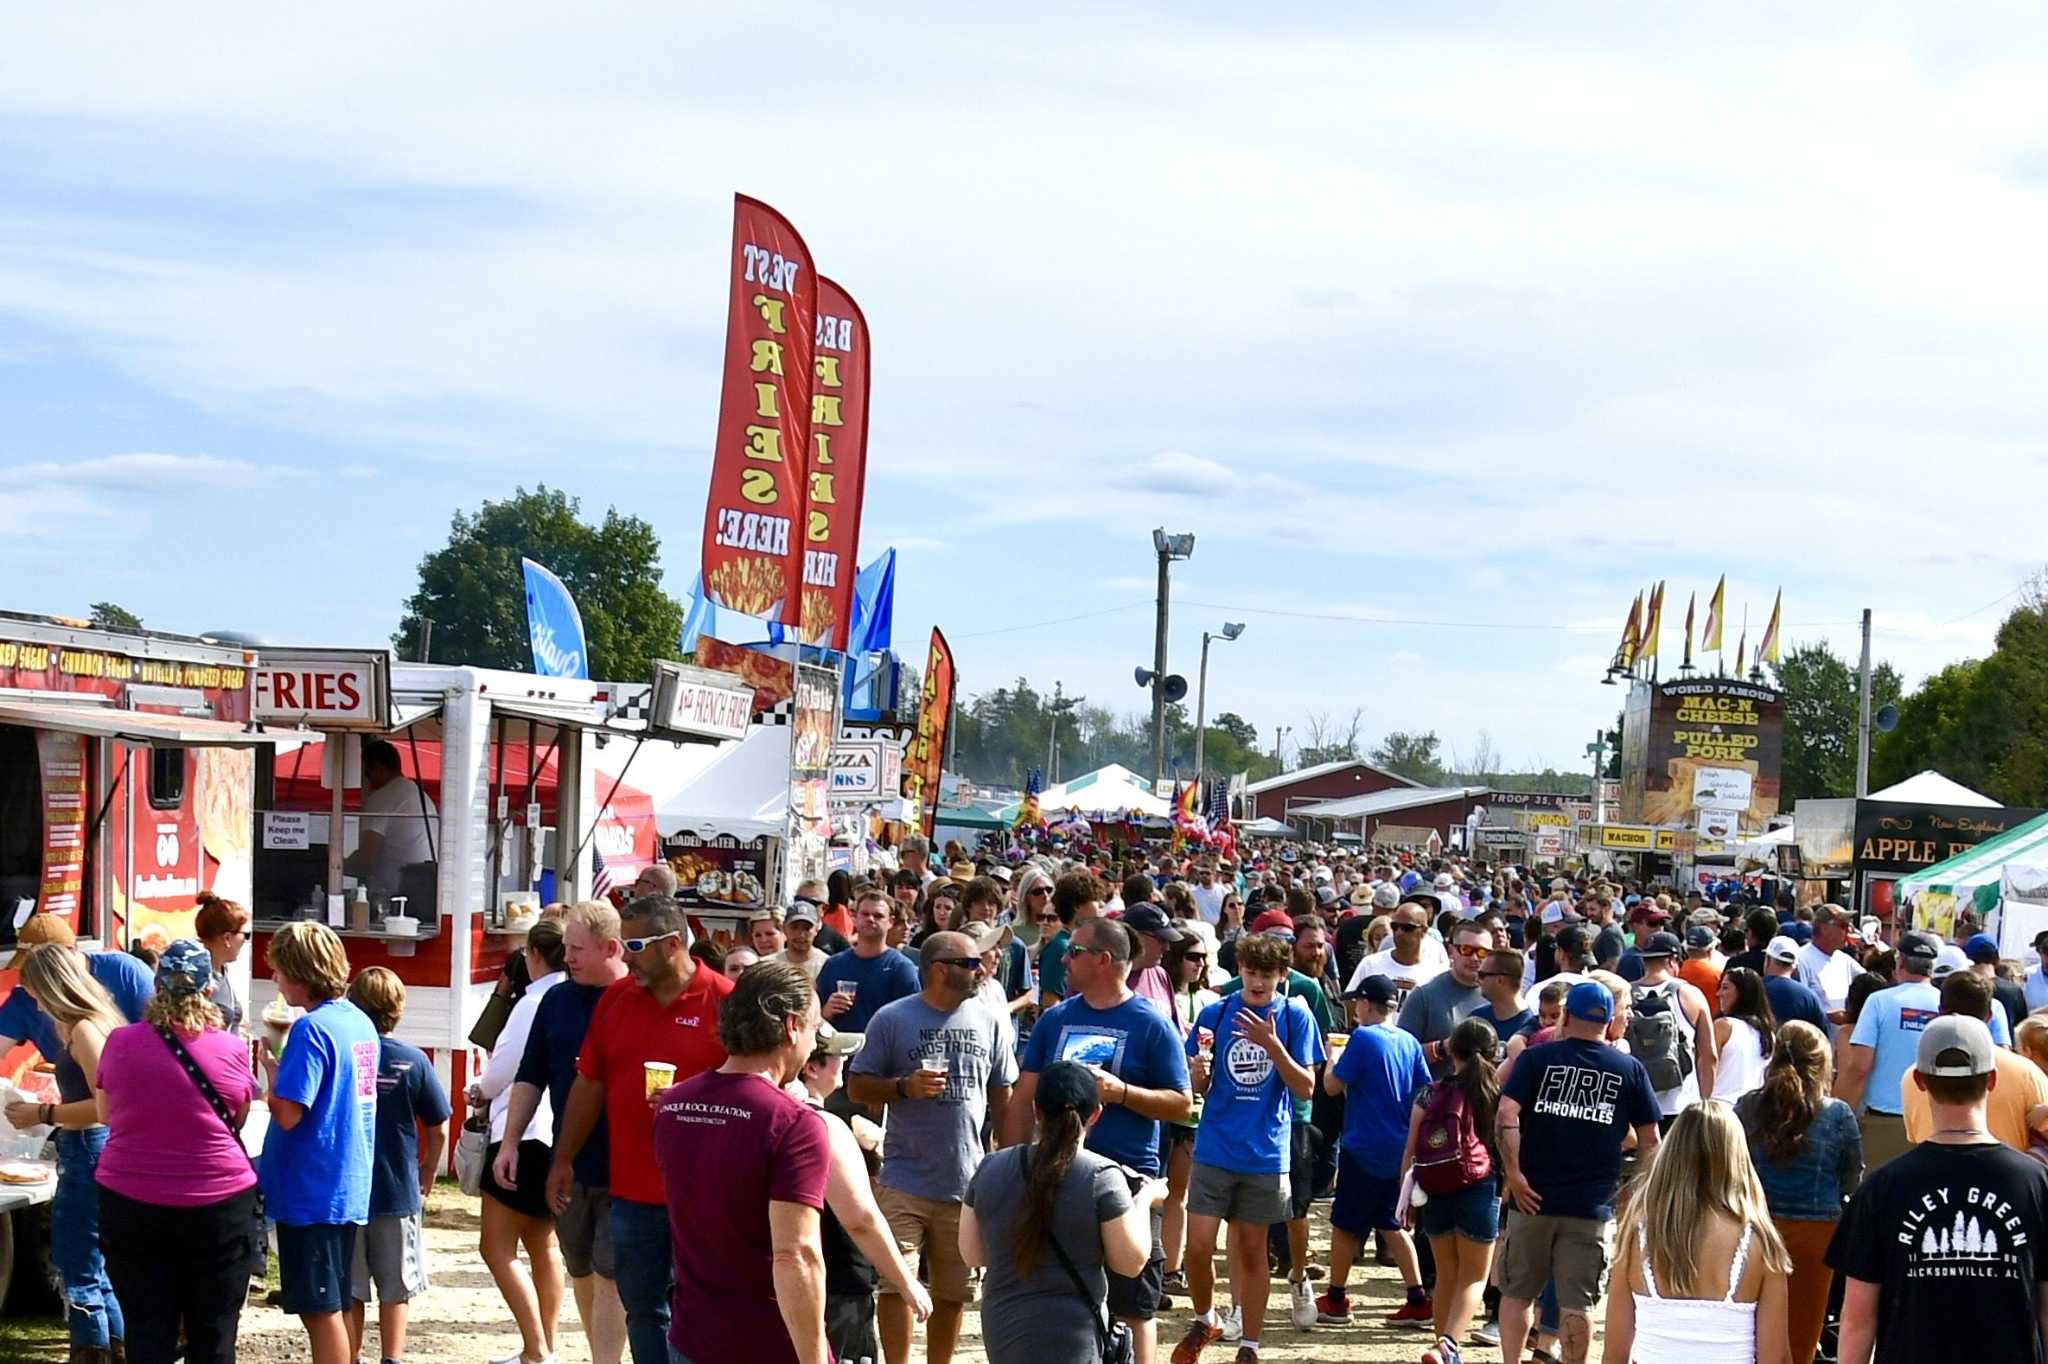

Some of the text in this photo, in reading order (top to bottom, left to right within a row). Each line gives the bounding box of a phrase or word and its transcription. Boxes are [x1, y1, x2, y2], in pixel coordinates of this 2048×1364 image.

[256, 672, 360, 711] FRIES
[1662, 684, 1775, 703] WORLD FAMOUS
[694, 689, 729, 726] FRENCH
[726, 696, 749, 729] FRIES
[1683, 696, 1754, 711] MAC-N
[1676, 709, 1760, 726] CHEESE
[1711, 724, 1722, 733] &
[1673, 730, 1759, 748] PULLED
[1685, 745, 1745, 760] PORK
[1491, 793, 1530, 804] TROOP
[272, 814, 301, 823] Please
[1928, 815, 2005, 837] New England
[268, 826, 291, 835] Keep
[1608, 832, 1646, 843] NACHOS
[666, 835, 703, 848] LOADED
[1860, 837, 1937, 864] APPLE
[919, 1028, 977, 1042] NEGATIVE
[1536, 1065, 1623, 1109] FIRE
[684, 1102, 708, 1113] ROCK
[709, 1105, 753, 1120] CREATIONS
[1534, 1100, 1614, 1125] CHRONICLES
[1898, 1187, 2028, 1247] RILEY GREEN
[2004, 1268, 2020, 1279] AL
